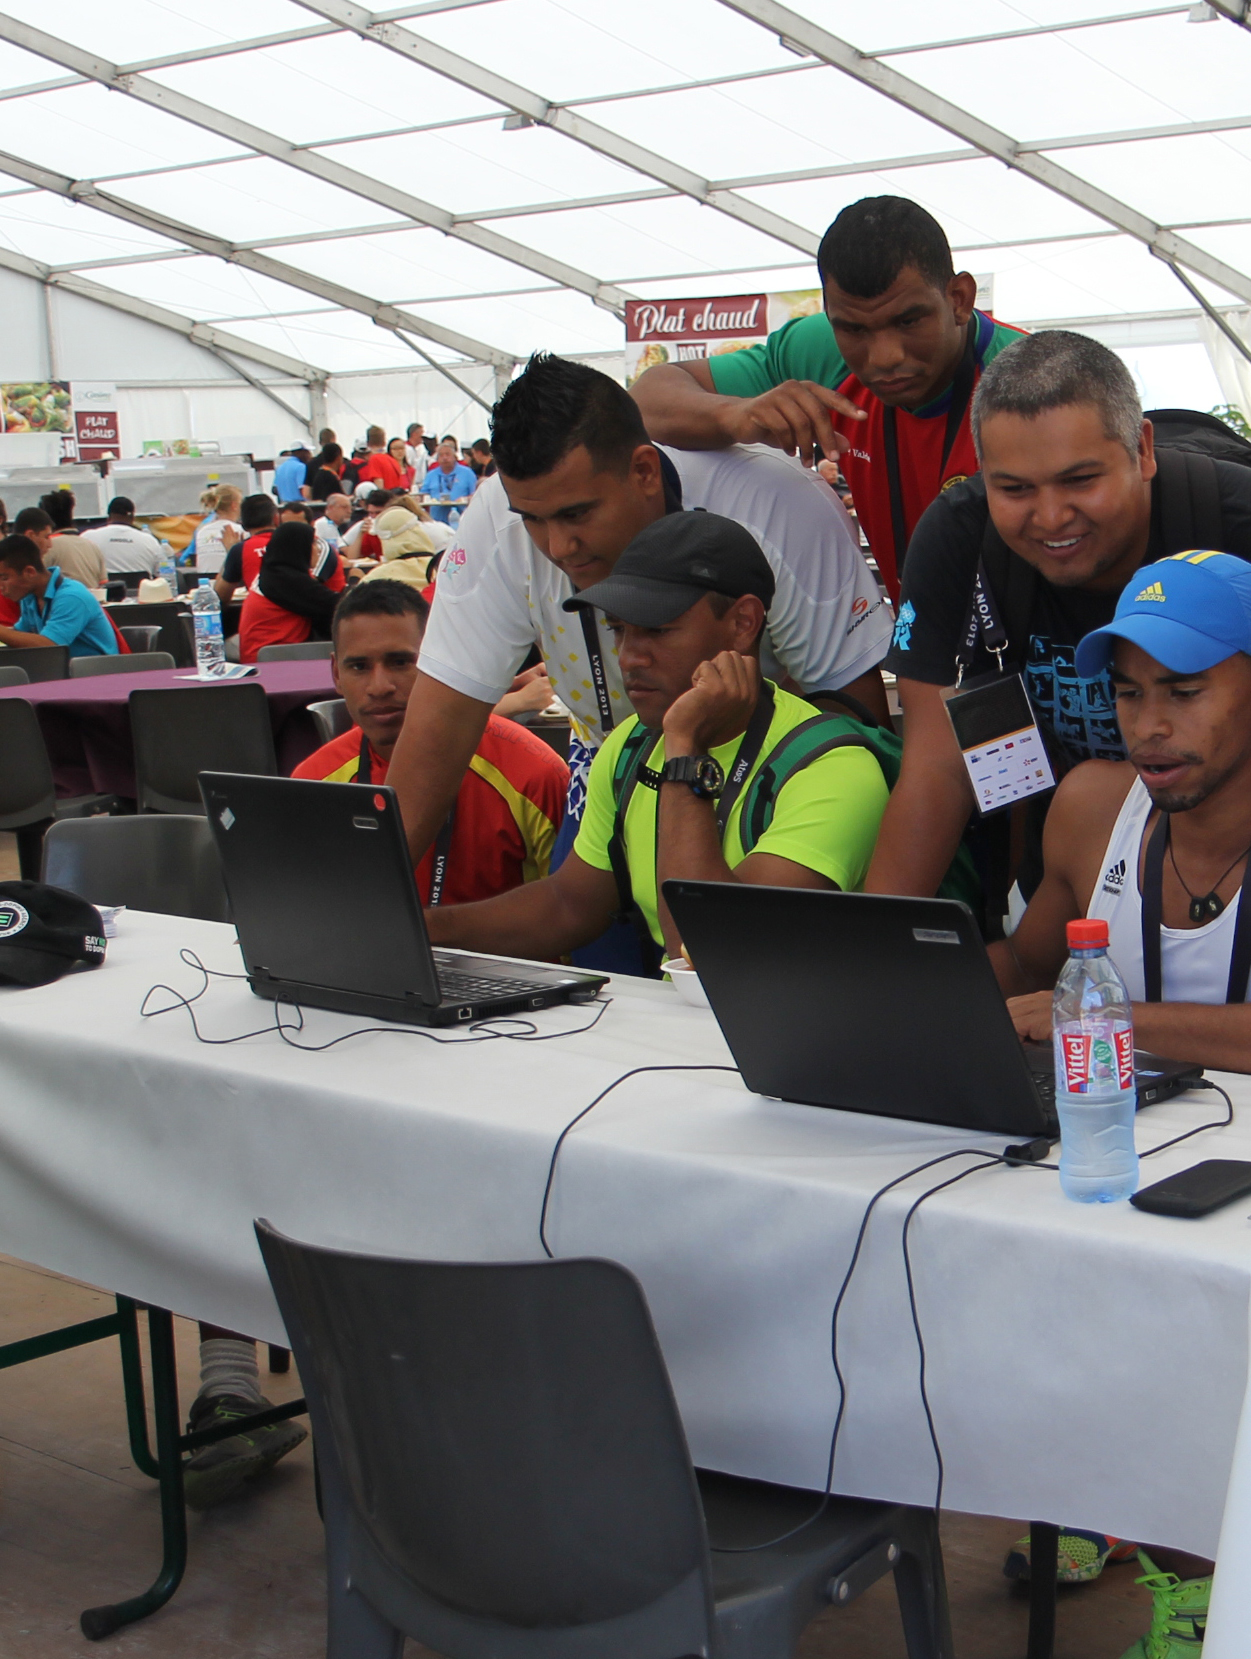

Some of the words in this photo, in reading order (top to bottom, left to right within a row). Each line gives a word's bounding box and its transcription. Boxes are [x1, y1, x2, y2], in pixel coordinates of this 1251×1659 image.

[634, 304, 687, 339] Plat
[692, 299, 760, 331] chaud
[678, 345, 706, 360] HOT
[79, 428, 116, 439] CHAUD
[85, 416, 109, 426] PLAT
[976, 593, 994, 630] LYON
[1134, 593, 1167, 603] adidas
[592, 654, 603, 686] LYON
[599, 689, 609, 716] 2013
[435, 855, 445, 883] LYON
[85, 935, 99, 946] SAY
[1067, 1037, 1085, 1087] Vittel
[1119, 1032, 1132, 1084] Vittel
